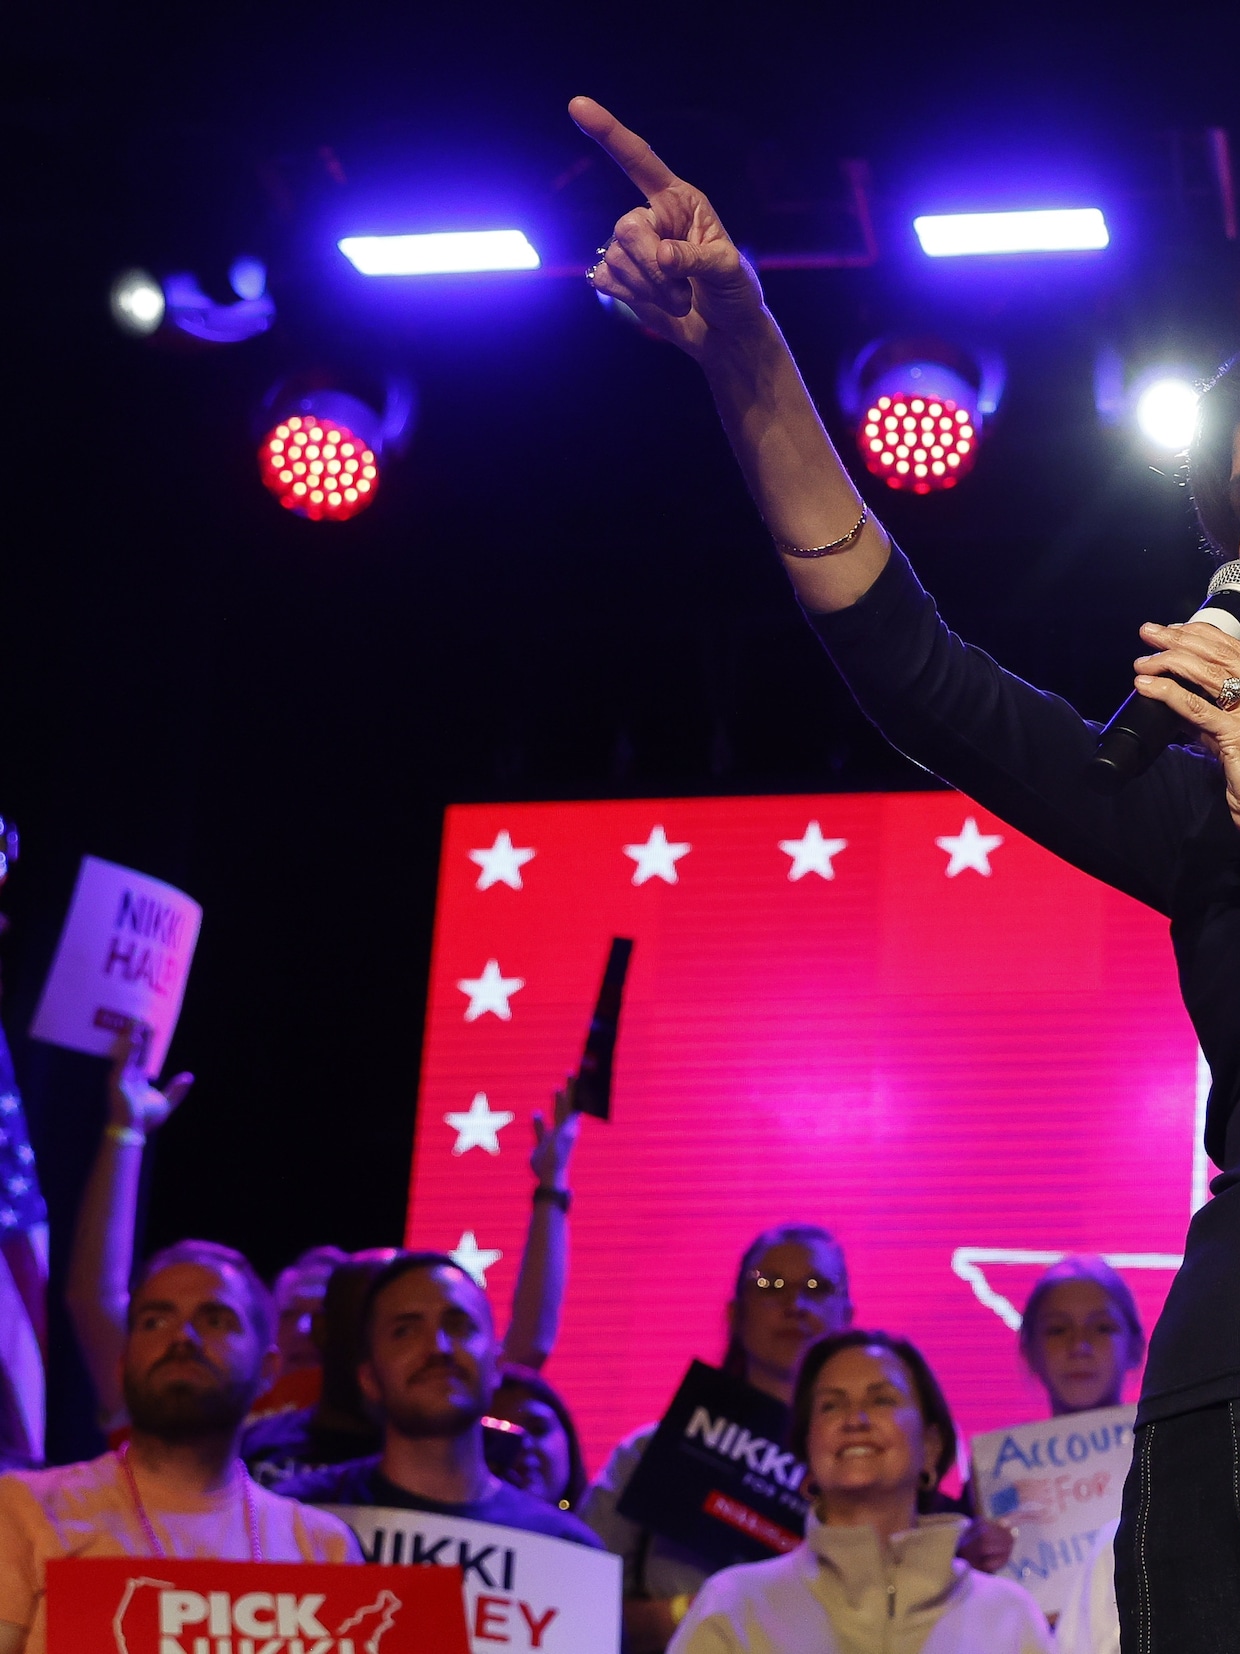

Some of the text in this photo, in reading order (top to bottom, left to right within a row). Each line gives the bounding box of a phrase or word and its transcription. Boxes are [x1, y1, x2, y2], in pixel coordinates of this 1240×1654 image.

[685, 1404, 807, 1492] NIKKI
[159, 1590, 331, 1638] PICK
[474, 1595, 560, 1648] EY
